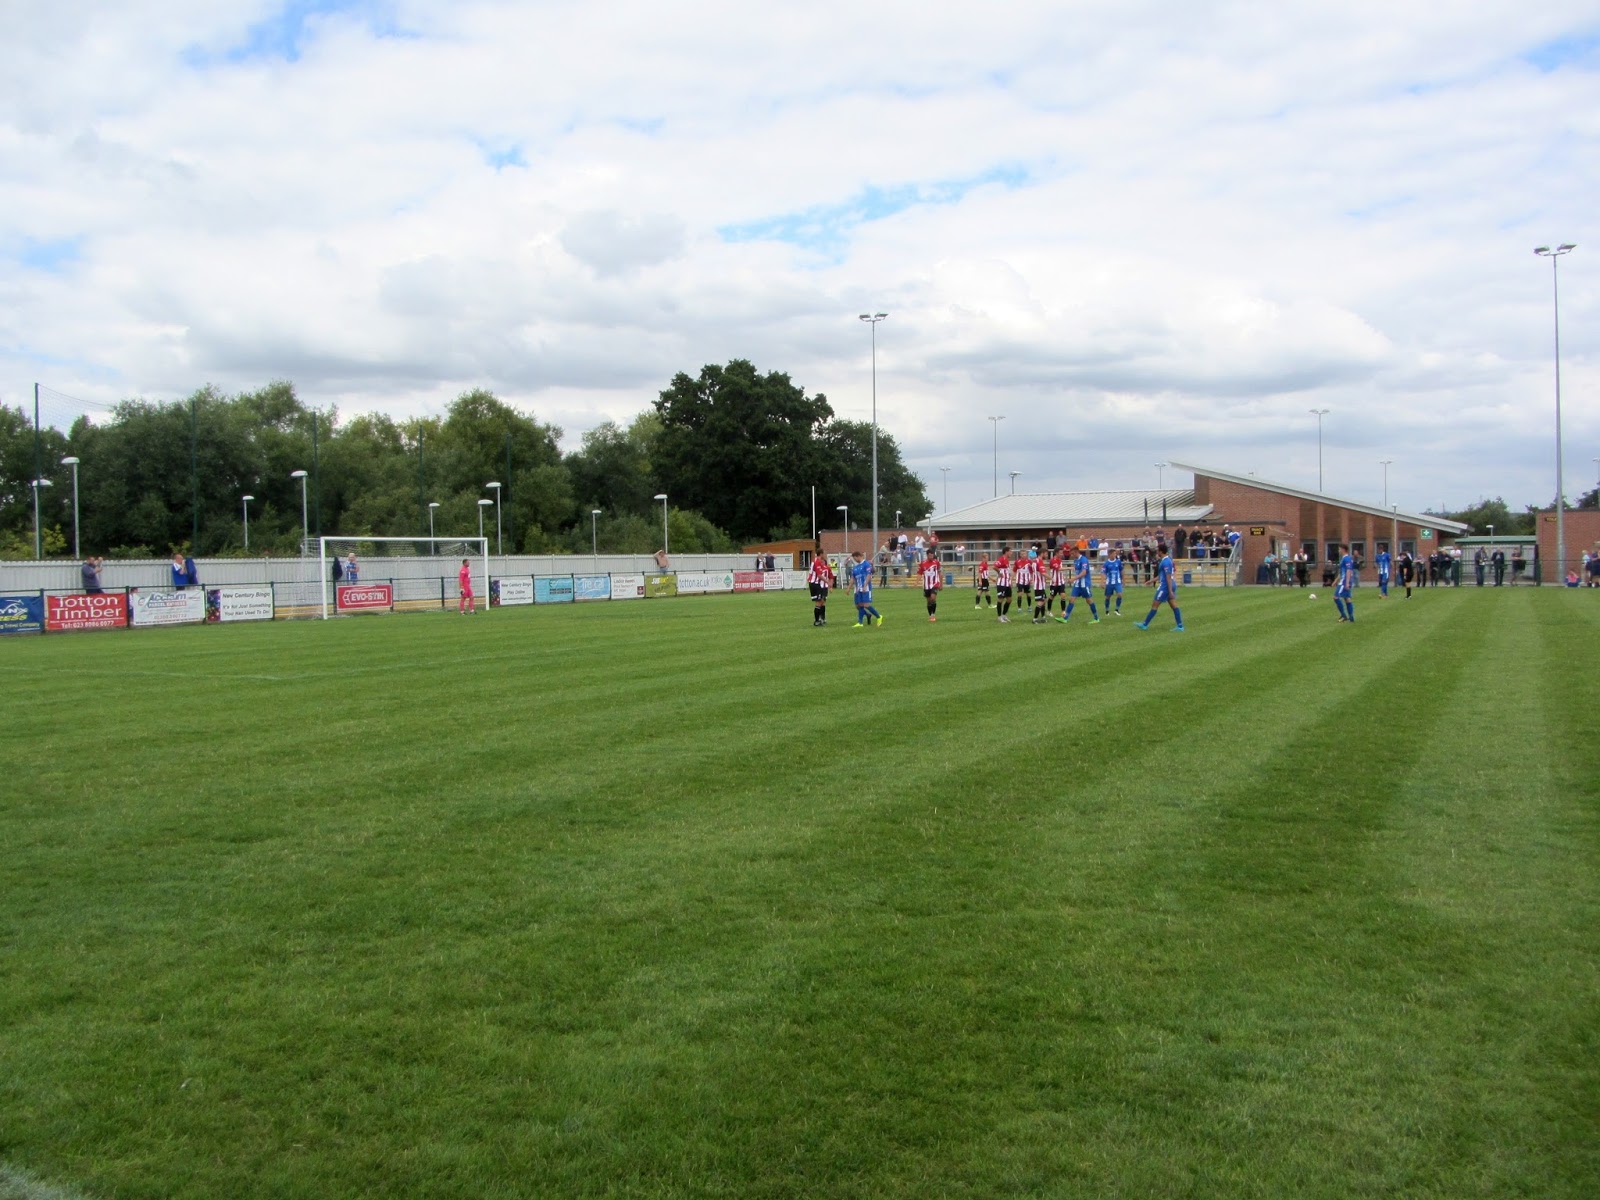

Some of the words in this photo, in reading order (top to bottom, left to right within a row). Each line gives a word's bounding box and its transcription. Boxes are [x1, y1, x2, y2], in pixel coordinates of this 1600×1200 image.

[256, 591, 271, 599] Bingo
[351, 592, 385, 601] EVO-STIK
[55, 596, 118, 608] Totton
[51, 606, 122, 620] Timber
